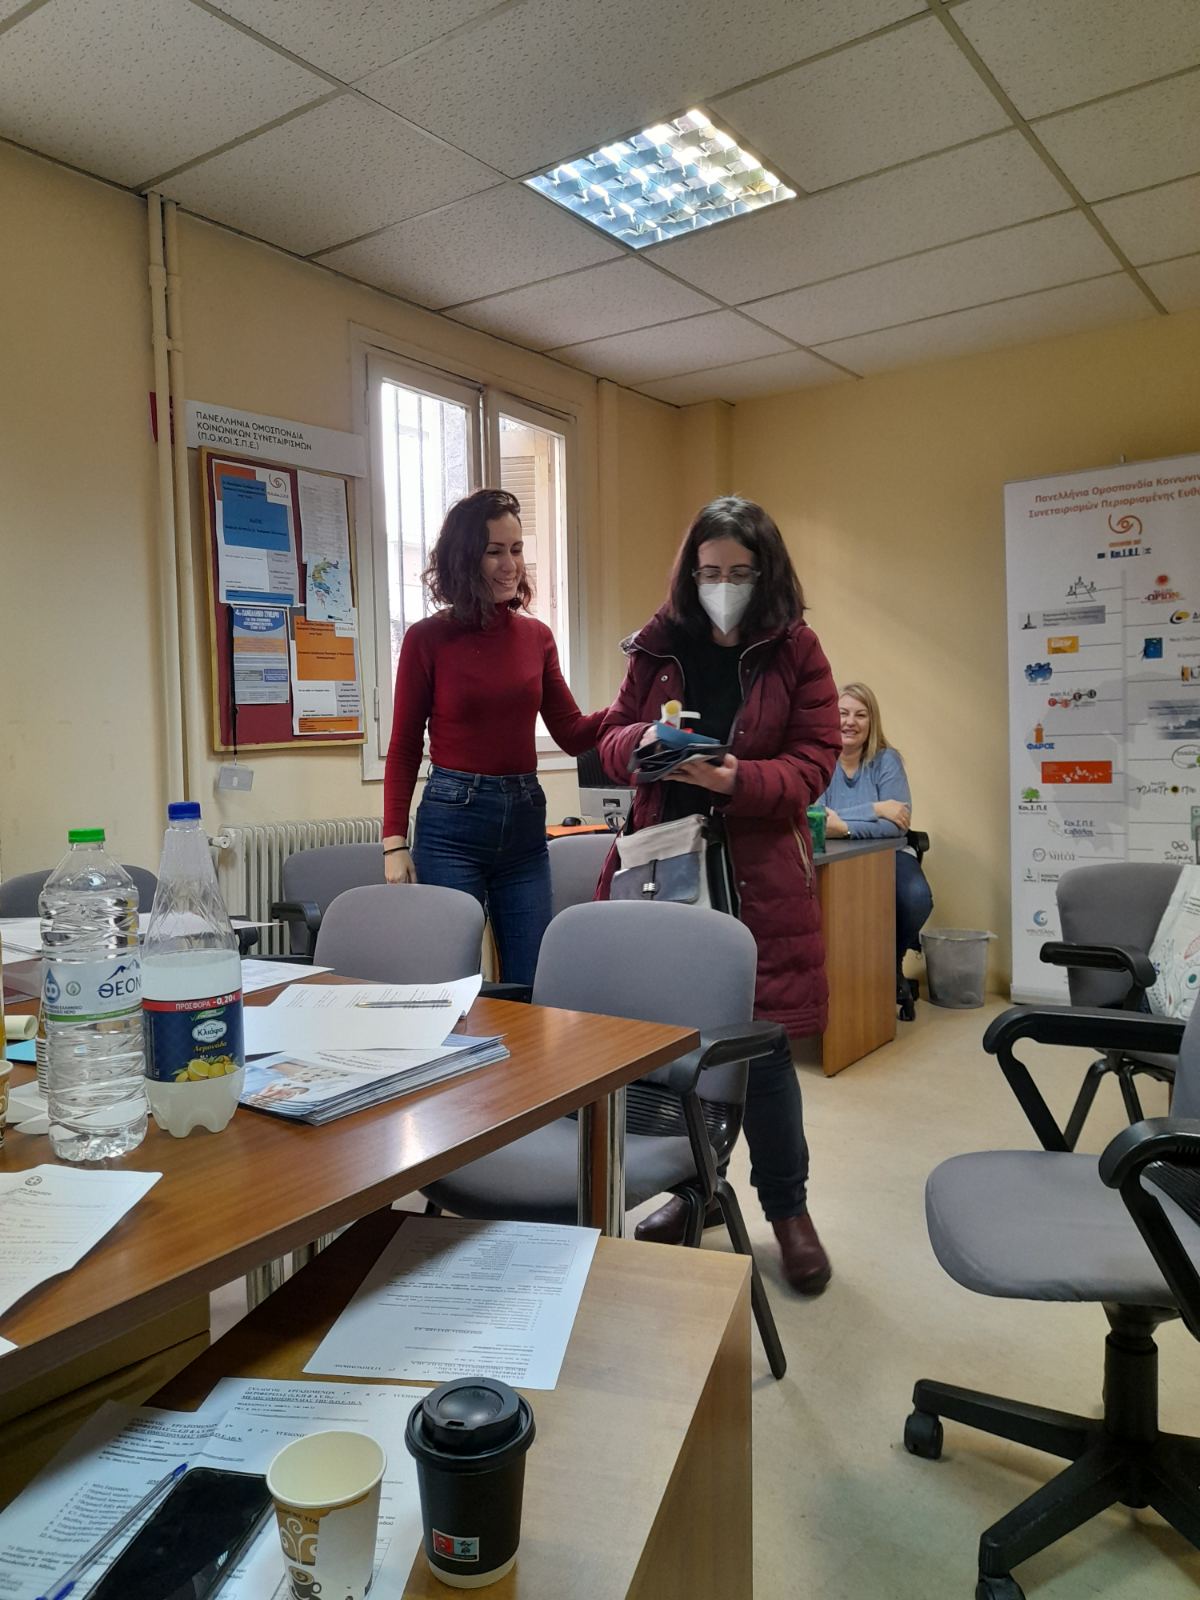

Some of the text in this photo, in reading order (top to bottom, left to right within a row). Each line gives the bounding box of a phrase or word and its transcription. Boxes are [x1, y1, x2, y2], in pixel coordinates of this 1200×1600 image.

[196, 411, 304, 440] ΠΑΝΕΛΛΗΝΙΑ ΟΜΟΣΠΟΝΔΙΑ
[197, 421, 312, 451] ΚΟΙΝΩΝΙΚΩΝ ΣΥΝΕΤΑΙΡΙΣΜΩΝ
[1035, 488, 1089, 504] Πανελλήνια
[1092, 480, 1153, 496] Ομοσπονδία
[1028, 501, 1099, 519] Συνεταιρισμών
[1101, 492, 1175, 509] Περιορισμένης
[1027, 742, 1055, 750] ΦΑΡΟΣ
[175, 1000, 211, 1011] ΠΡΟΣΦΟΡΑ
[197, 1026, 224, 1037] Κλιάφα
